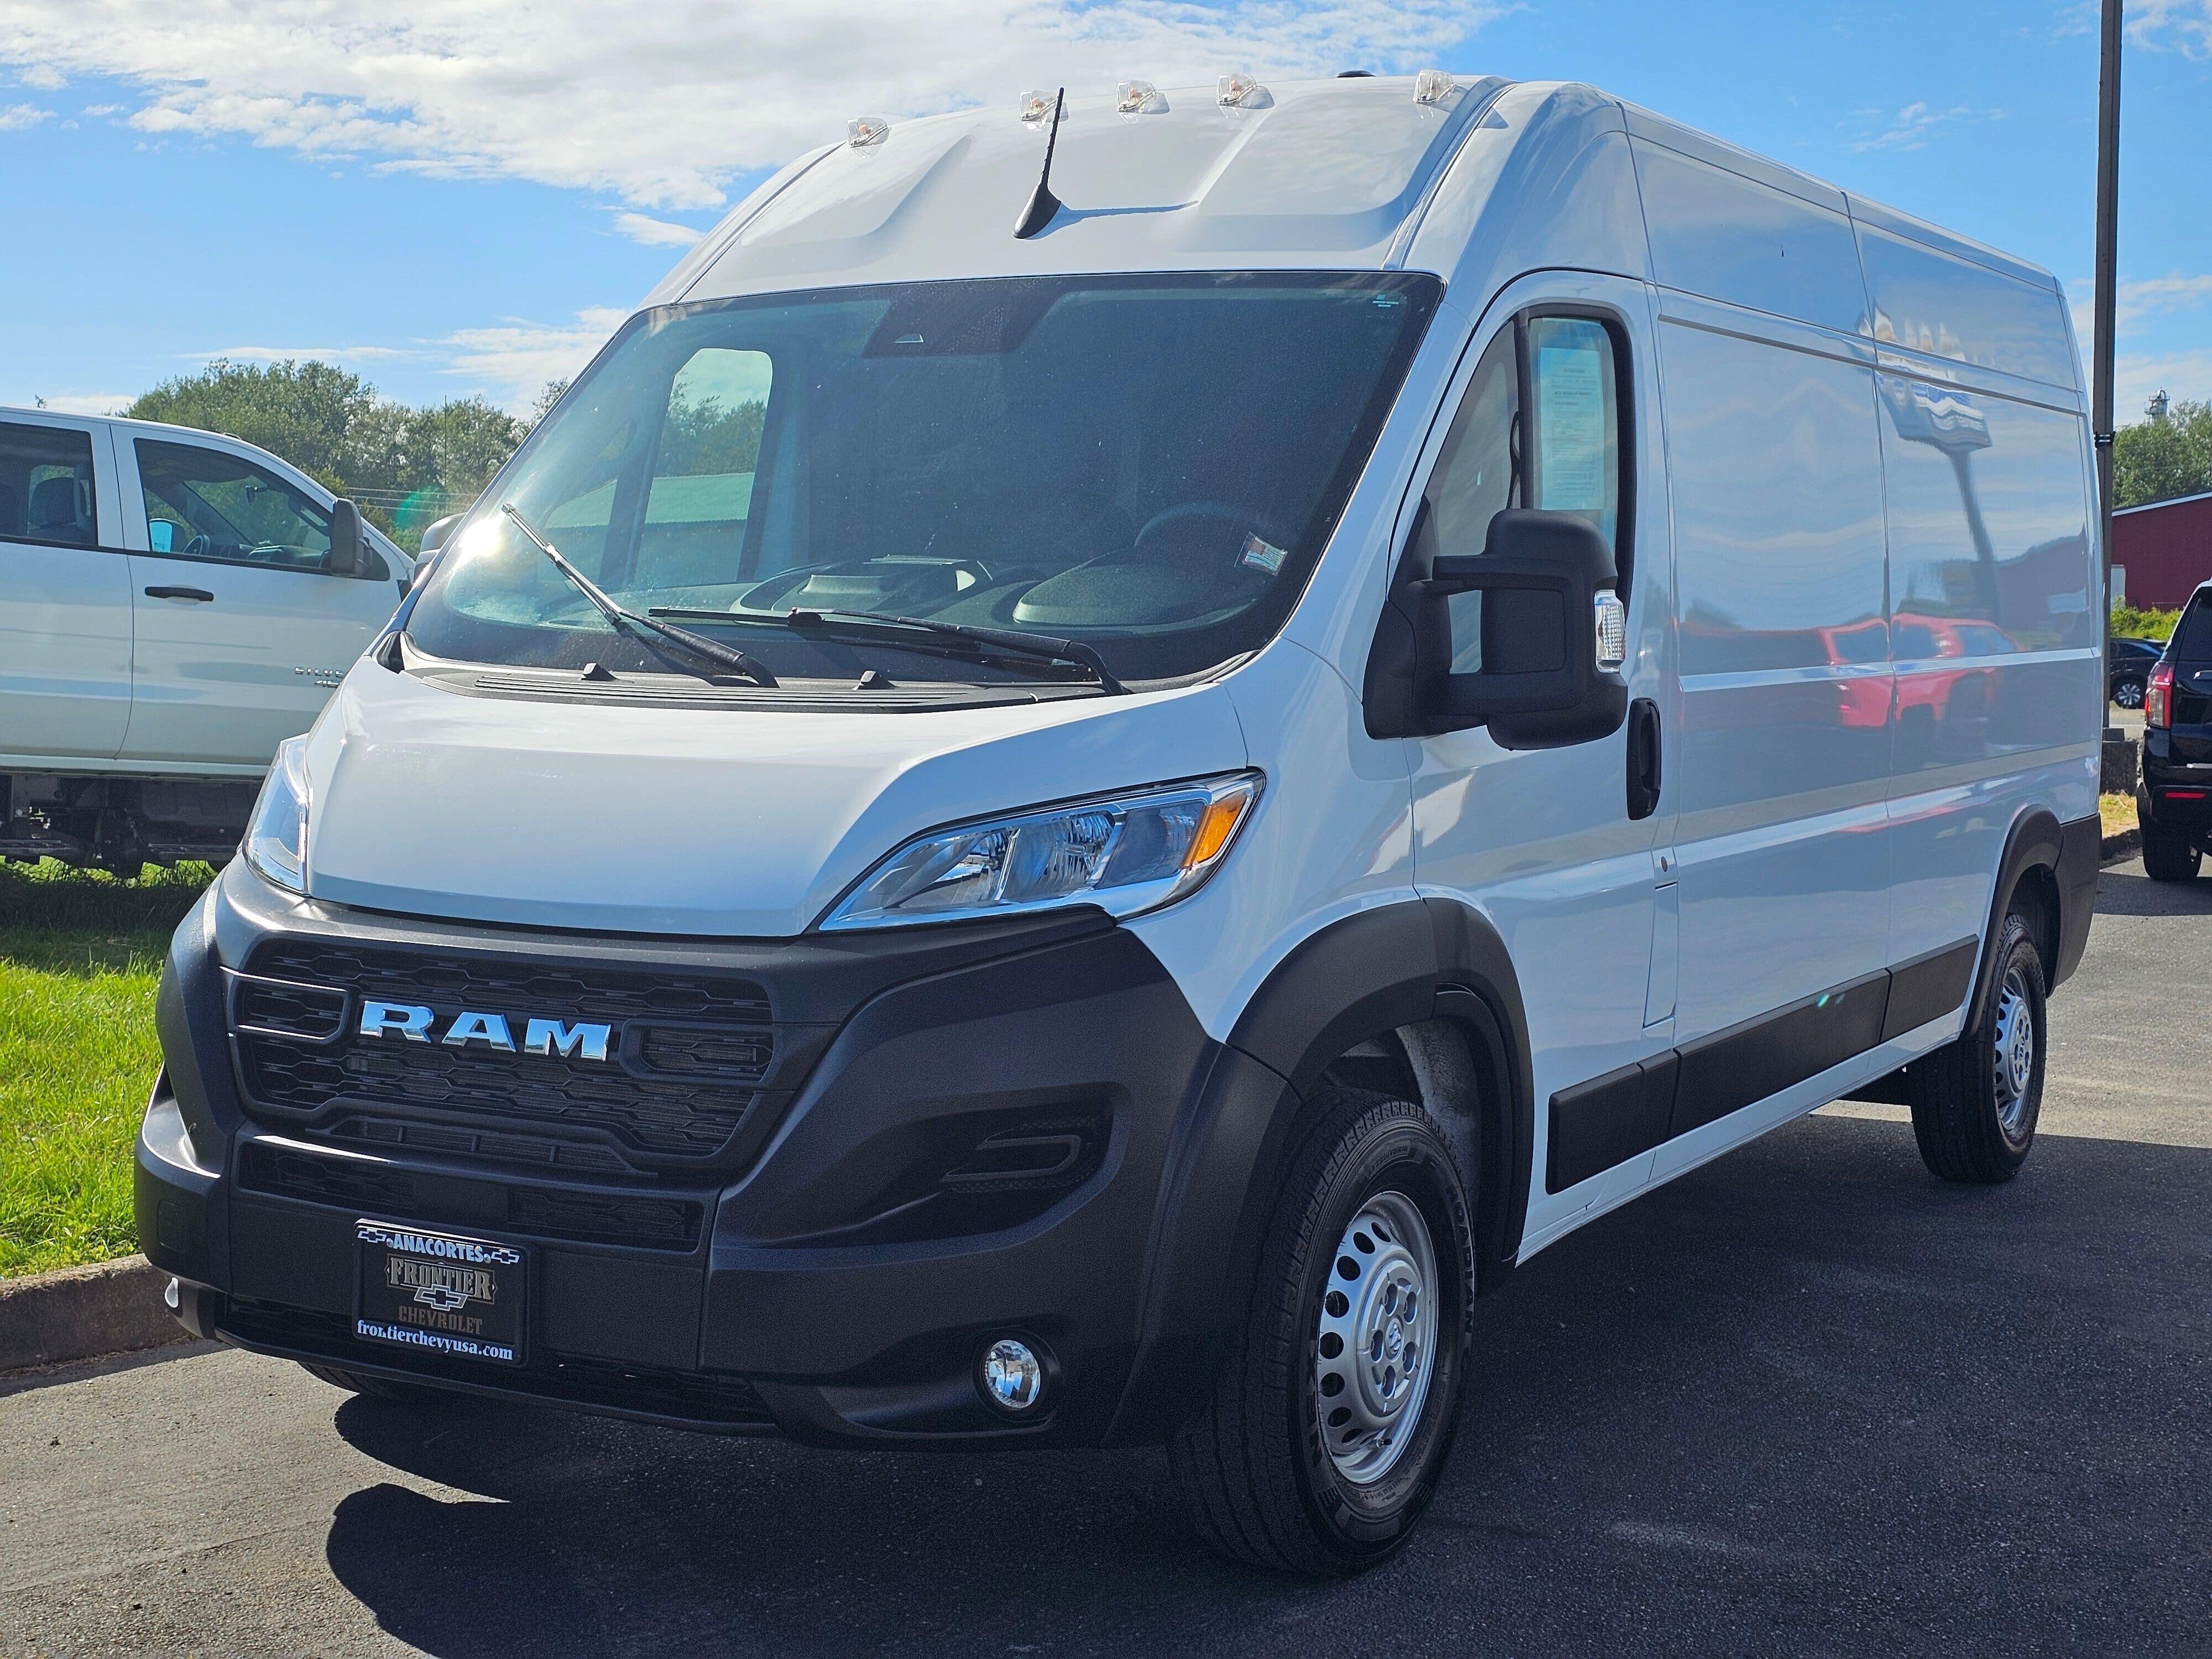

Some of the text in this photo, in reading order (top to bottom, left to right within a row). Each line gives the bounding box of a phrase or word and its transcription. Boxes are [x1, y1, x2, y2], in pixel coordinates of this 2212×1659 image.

[359, 1000, 611, 1061] RAM
[392, 1234, 484, 1263] ANACORTES
[390, 1257, 492, 1300] FRONTIER
[398, 1306, 483, 1335] CHEVROLET
